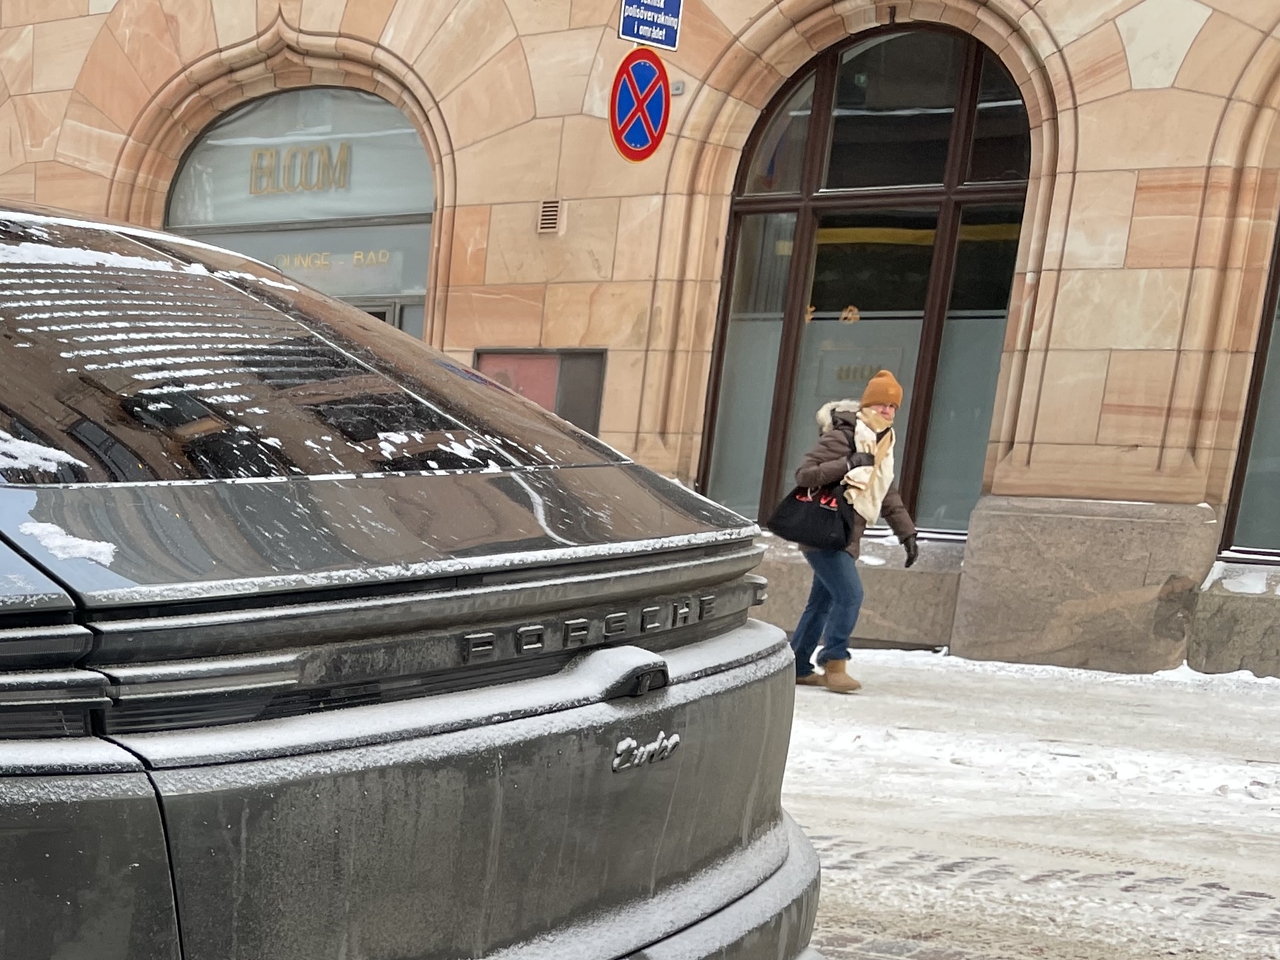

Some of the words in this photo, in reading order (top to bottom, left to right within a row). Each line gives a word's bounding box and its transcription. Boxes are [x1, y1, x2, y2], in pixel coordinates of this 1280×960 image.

[624, 4, 678, 30] polisövervakning
[249, 142, 350, 195] BLOOM
[272, 251, 331, 269] OUNGE
[353, 249, 390, 265] BAR
[463, 595, 716, 664] PORSCHE
[612, 730, 681, 773] Turbo
